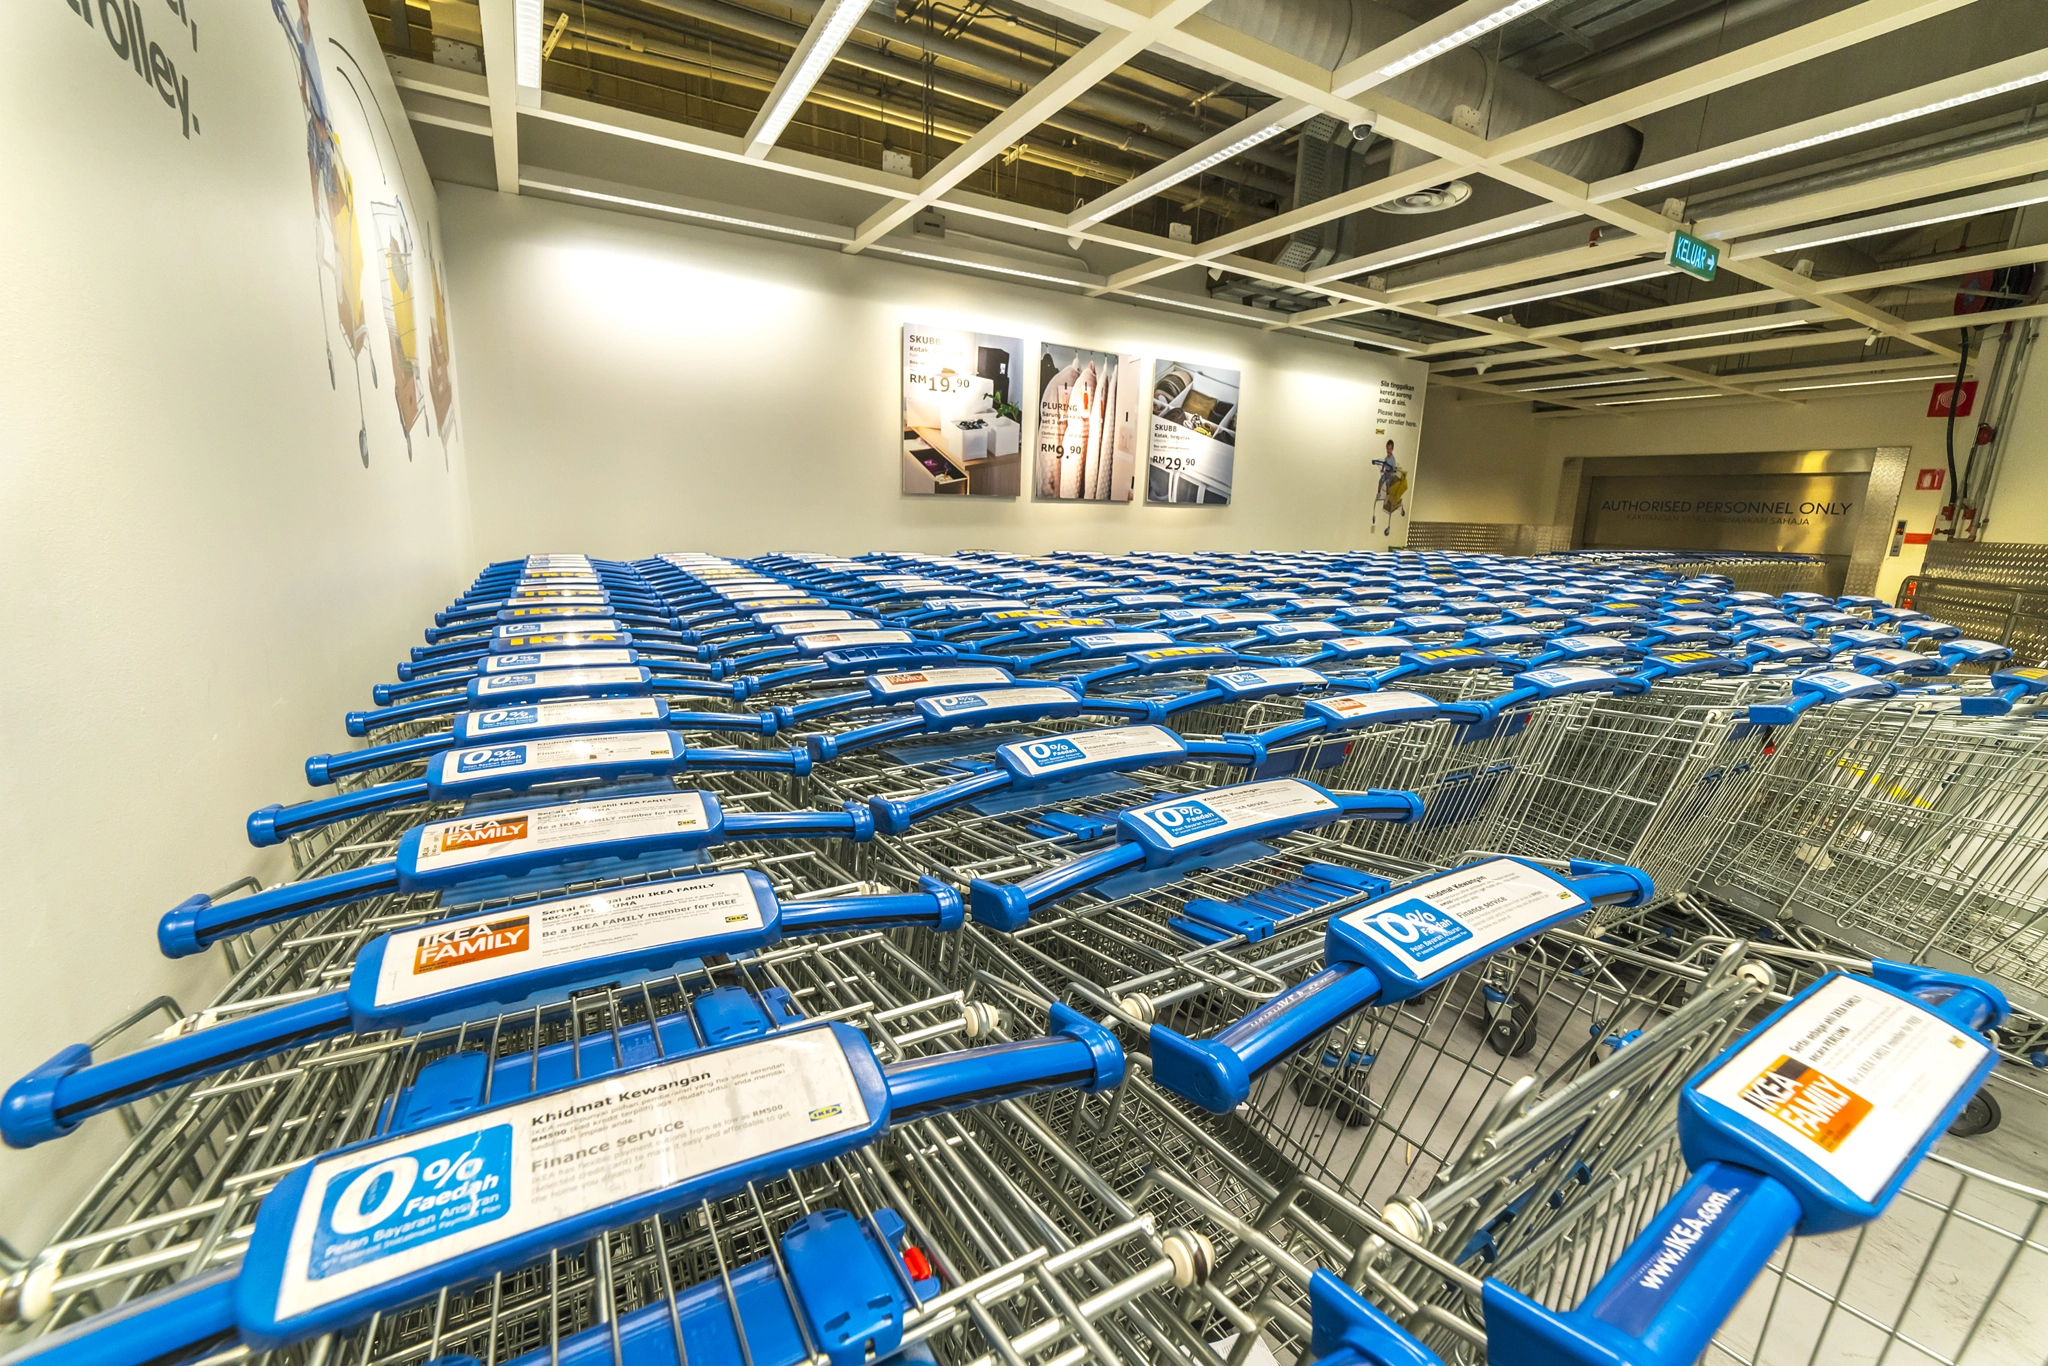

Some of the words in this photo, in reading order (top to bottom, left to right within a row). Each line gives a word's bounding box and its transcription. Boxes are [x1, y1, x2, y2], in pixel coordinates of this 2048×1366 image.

[1675, 236, 1707, 270] KELUAR
[909, 334, 941, 346] SKUBB
[909, 373, 970, 393] RM19.90
[1042, 401, 1077, 411] PLURING
[1378, 408, 1393, 416] Please
[1154, 423, 1177, 432] SKUBB
[1041, 443, 1082, 459] RM9.90
[1152, 455, 1195, 471] RM29.90
[1601, 500, 1692, 513] AUTHORISED
[1695, 501, 1794, 515] PERSONNEL
[1798, 501, 1853, 515] ONLY
[1769, 517, 1810, 525] SAHAJA
[1035, 618, 1105, 629] IKEA
[483, 711, 528, 723] 0%
[463, 748, 516, 765] 0%
[1029, 743, 1068, 759] 0%
[1248, 800, 1270, 808] service
[584, 816, 616, 825] FAMILY
[618, 812, 652, 820] member
[1155, 806, 1203, 827] 0%
[1186, 812, 1215, 823] Faedah
[446, 823, 525, 846] FAMILY
[449, 820, 500, 834] IKEA
[542, 906, 576, 916] Sertai
[625, 894, 645, 902] ahli
[648, 889, 674, 897] IKEA
[676, 883, 715, 893] FAMILY
[1425, 886, 1454, 900] Khidmat
[542, 911, 580, 922] secara
[571, 922, 599, 932] IKEA
[602, 913, 645, 925] FAMILY
[648, 906, 691, 918] member
[711, 899, 737, 908] FREE
[1456, 905, 1485, 919] Finance
[1484, 896, 1508, 909] service
[423, 924, 493, 948] IKEA
[1376, 909, 1436, 944] 0%
[420, 929, 526, 964] FAMILY
[1409, 943, 1425, 953] Pelan
[1423, 934, 1445, 950] Bayaran
[532, 1097, 613, 1126] Khidmat
[619, 1072, 711, 1102] Kewangan
[557, 1110, 608, 1128] mempunyai
[611, 1101, 639, 1114] pilihan
[695, 1080, 715, 1091] yang
[750, 1063, 785, 1076] serendah
[1741, 1068, 1805, 1114] IKEA
[532, 1129, 567, 1143] RM500
[593, 1114, 618, 1126] kredit
[621, 1105, 654, 1118] terpilih)
[678, 1090, 706, 1102] mudah
[753, 1069, 786, 1081] memiliki
[1777, 1074, 1852, 1138] FAMILY
[611, 1118, 636, 1129] anda.
[532, 1142, 610, 1173] Finance
[616, 1119, 684, 1148] service
[558, 1166, 575, 1176] has
[578, 1154, 611, 1169] flexible
[614, 1142, 653, 1159] payment
[691, 1125, 710, 1135] from
[712, 1121, 723, 1129] as
[724, 1116, 739, 1126] low
[740, 1113, 751, 1121] as
[752, 1103, 784, 1117] RM500
[578, 1166, 605, 1180] credit
[609, 1158, 632, 1171] card)
[635, 1154, 645, 1162] to
[682, 1137, 702, 1149] easy
[705, 1130, 721, 1141] and
[723, 1117, 765, 1136] affordable
[766, 1113, 776, 1122] to
[777, 1109, 791, 1122] get
[331, 1151, 485, 1234] 0%
[550, 1185, 578, 1198] home
[581, 1178, 599, 1191] you
[601, 1167, 632, 1183] dream
[403, 1173, 499, 1217] Faedah
[481, 1203, 502, 1216] Plan
[324, 1236, 369, 1259] Pelan
[373, 1213, 437, 1243] Bayaran
[440, 1192, 500, 1221] Ansuran
[1639, 1191, 1732, 1290] www.IKEA.com
